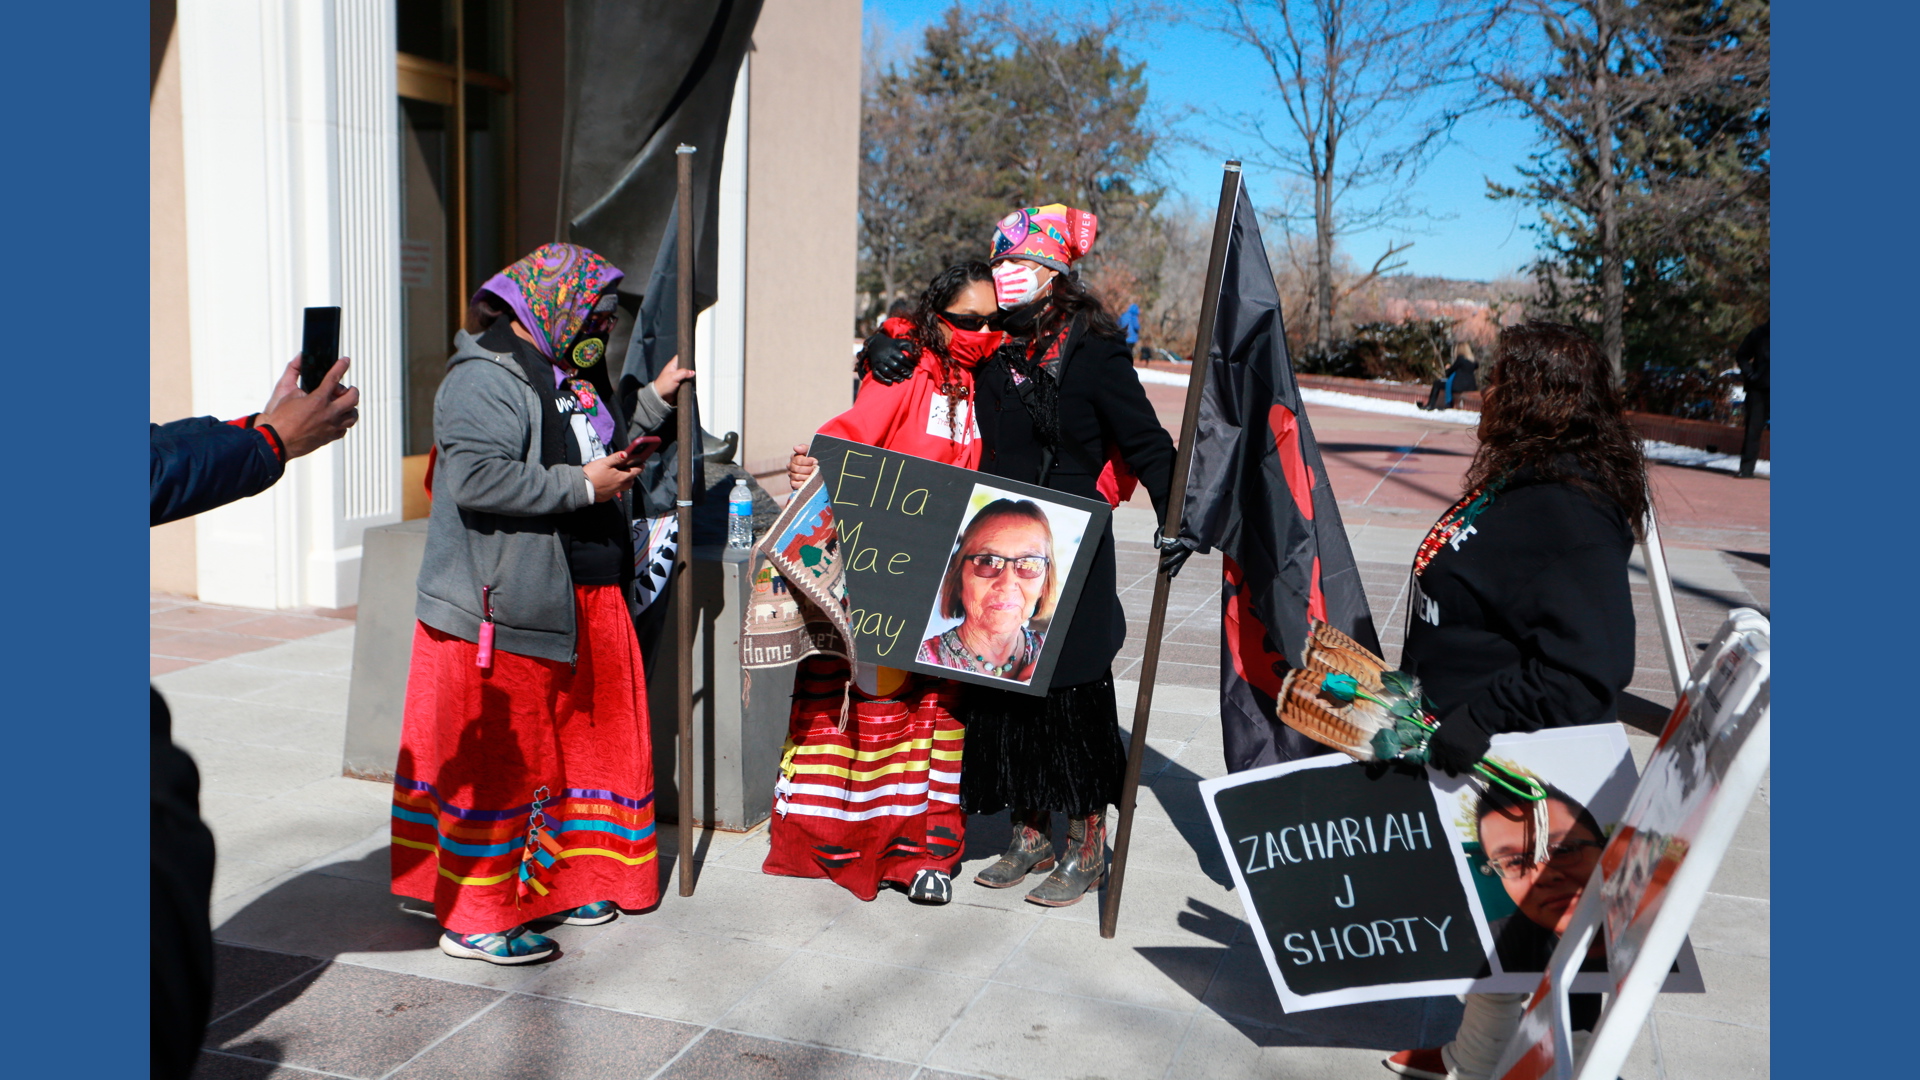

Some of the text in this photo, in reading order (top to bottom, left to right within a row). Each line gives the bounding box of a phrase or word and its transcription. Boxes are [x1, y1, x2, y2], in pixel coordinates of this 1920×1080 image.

[833, 450, 929, 516] Ella
[836, 519, 911, 575] Mae
[743, 636, 792, 664] Home
[851, 608, 906, 657] gay
[1239, 811, 1432, 874] ZACHARIAH
[1335, 874, 1355, 908] J
[1284, 915, 1452, 965] SHORTY
